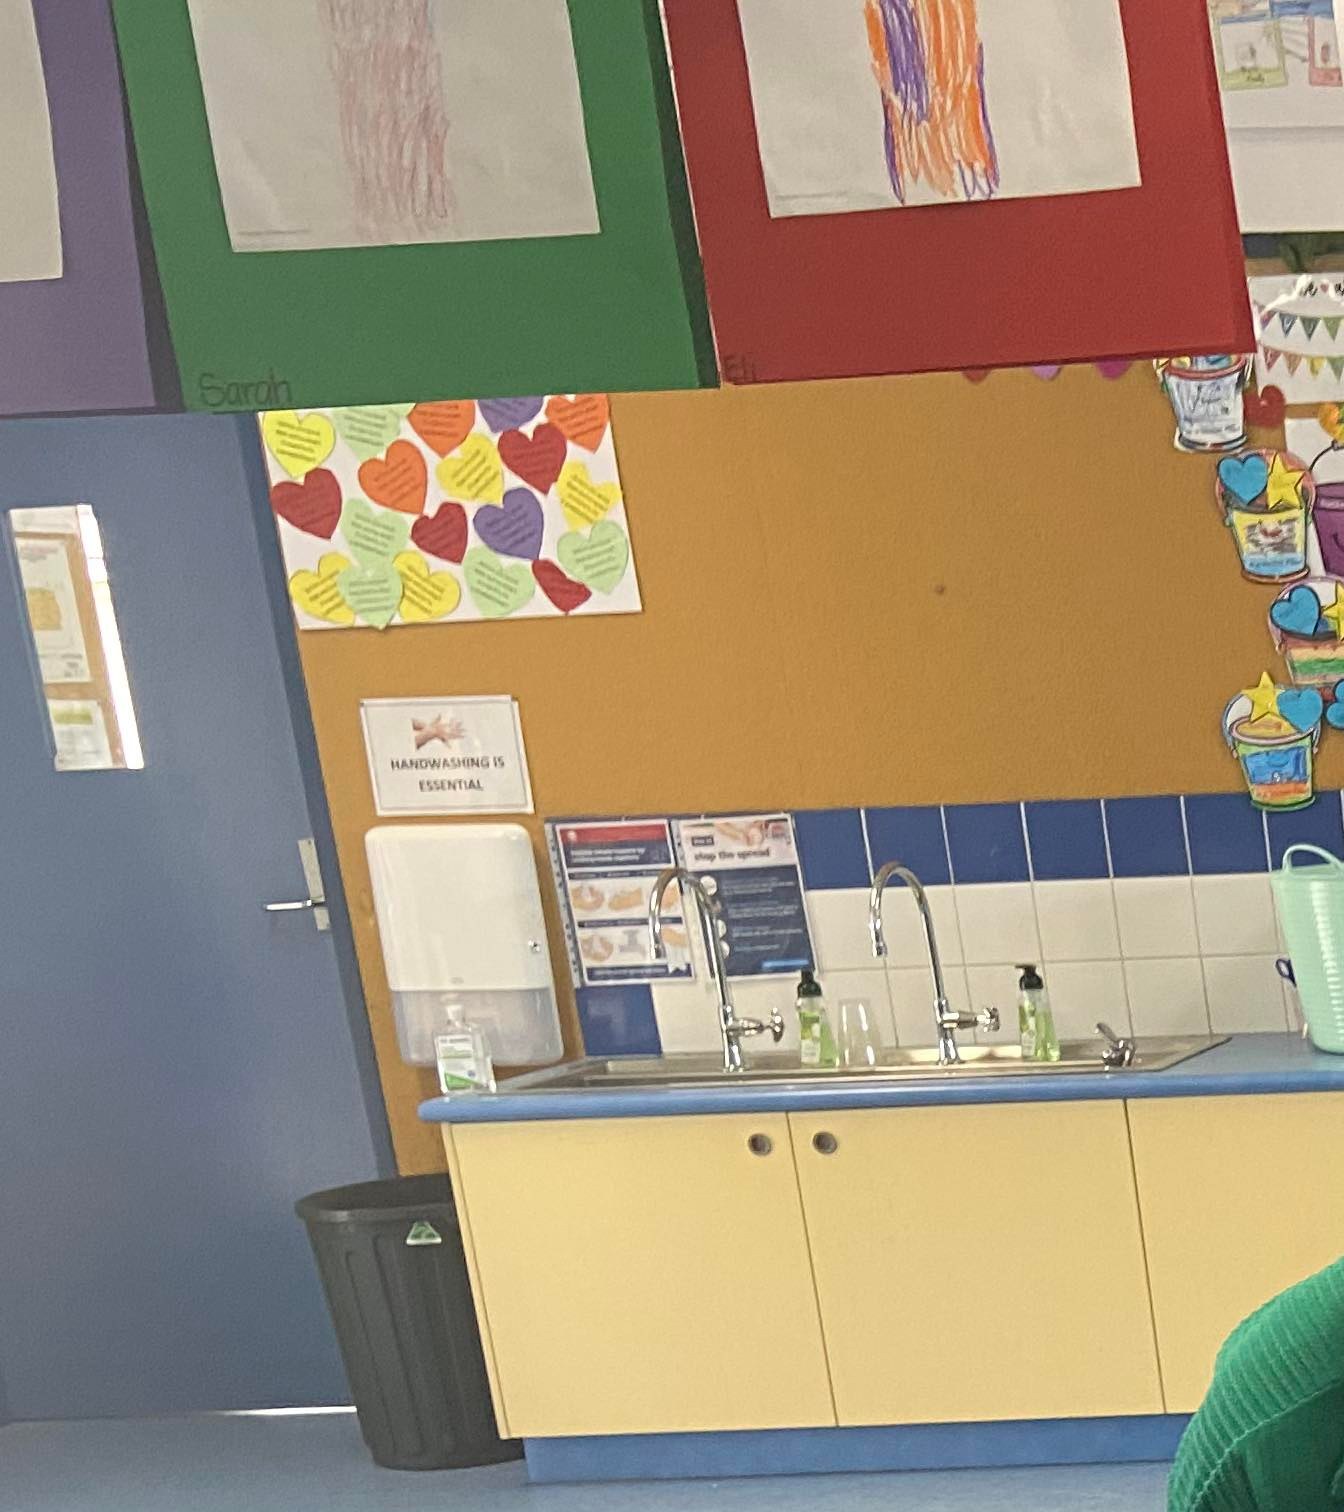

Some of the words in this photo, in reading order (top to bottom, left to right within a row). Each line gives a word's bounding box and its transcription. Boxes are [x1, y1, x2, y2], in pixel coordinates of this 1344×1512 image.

[200, 368, 292, 407] Sarah
[390, 757, 490, 772] HANDWASHING
[493, 755, 505, 769] IS
[419, 778, 484, 793] ESSENTIAL
